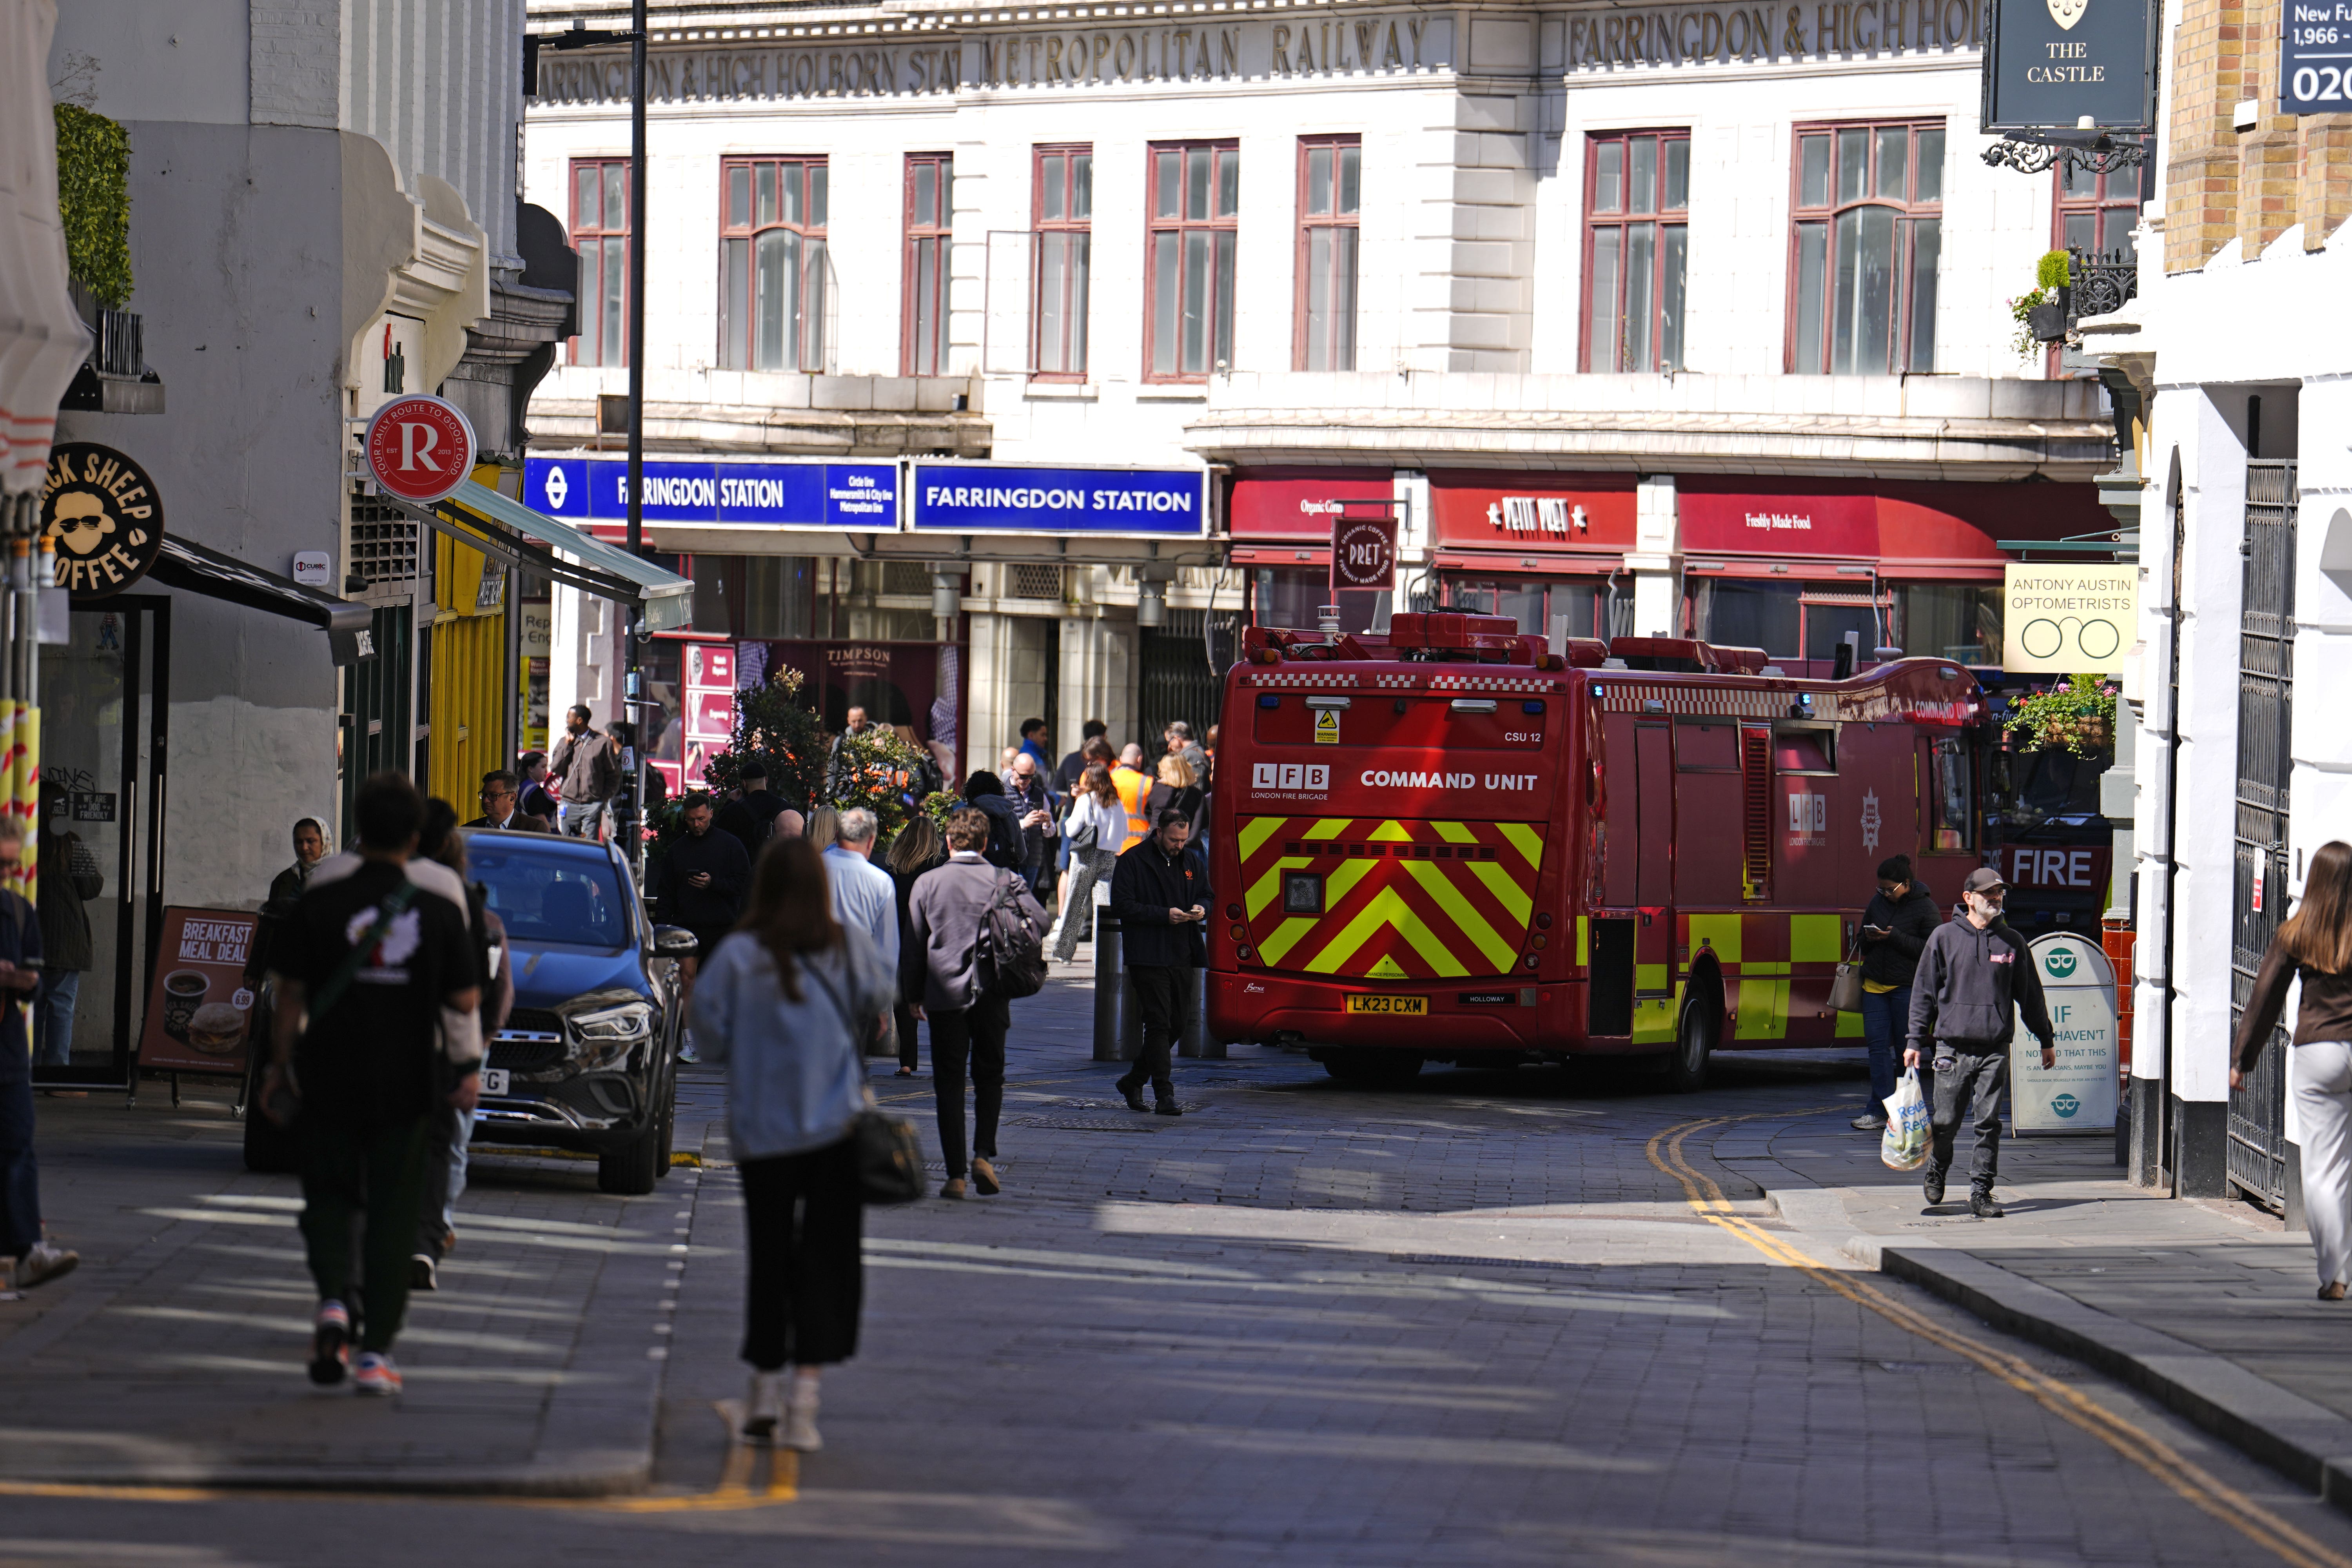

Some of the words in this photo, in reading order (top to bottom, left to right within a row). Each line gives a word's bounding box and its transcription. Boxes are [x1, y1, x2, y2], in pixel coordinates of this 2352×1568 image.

[2294, 4, 2331, 22] New
[1570, 9, 1773, 65] FARRINGDON
[1783, 5, 1806, 56] &
[1816, 0, 1906, 53] HIGH
[2293, 27, 2338, 47] 1,966
[980, 27, 1240, 87] METROPOLITAN
[1270, 18, 1430, 73] RAILWAY
[2046, 43, 2087, 58] THE
[682, 60, 699, 102] &
[706, 55, 767, 101] HIGH
[776, 49, 898, 99] HOLBORN
[2027, 66, 2104, 83] CASTLE
[390, 404, 425, 419] ROUTE
[429, 406, 442, 417] TO
[374, 418, 390, 446] DAILY
[443, 416, 463, 444] GOOD
[396, 423, 445, 472] R
[374, 449, 388, 477] YOUR
[84, 453, 152, 519] SHEEP
[849, 475, 864, 487] Circle
[864, 476, 875, 487] line
[618, 476, 716, 506] FRINGDON
[720, 478, 783, 508] STATION
[830, 488, 865, 499] Hammersmith
[866, 489, 871, 500] &
[871, 489, 882, 503] City
[882, 489, 893, 501] line
[926, 486, 1085, 510] FARRINGDON
[1093, 489, 1191, 512] STATION
[840, 501, 873, 514] Metropolitan
[873, 502, 883, 513] line
[1300, 499, 1324, 516] Organic
[1502, 496, 1537, 530] PETIT
[1537, 498, 1570, 532] PRET
[1746, 512, 1771, 531] Freshly
[1771, 512, 1792, 529] Made
[1793, 514, 1811, 530] Food
[1341, 524, 1367, 545] ORGANIC
[1368, 524, 1389, 545] COFFEE
[1349, 543, 1380, 566] PRET
[54, 543, 141, 590] OFFEE
[1338, 559, 1359, 583] FRESHLY
[1359, 573, 1377, 584] MADE
[1377, 559, 1390, 577] FOOD
[2013, 579, 2075, 591] ANTONY
[2078, 579, 2131, 591] AUSTIN
[2012, 597, 2131, 610] OPTOMETRISTS
[827, 647, 891, 662] TIMPSON
[1915, 700, 1954, 719] COMMAND
[1504, 732, 1527, 742] CSU
[1530, 733, 1541, 742] 12
[1259, 768, 1323, 785] LFB
[1361, 770, 1475, 789] COMMAND
[1485, 774, 1538, 791] UNIT
[83, 794, 93, 803] WE
[95, 795, 107, 803] ARE
[1789, 837, 1804, 846] LONDON
[2012, 849, 2092, 886] FIRE
[182, 922, 253, 944] BREAKFAST
[179, 940, 212, 960] MEAL
[216, 943, 246, 962] DEAL
[235, 995, 250, 1005] 6.99
[1354, 997, 1390, 1012] LK23
[1394, 998, 1422, 1013] CXM
[2054, 1005, 2072, 1023] IF
[2054, 1029, 2105, 1041] HAVEN'T
[2064, 1049, 2085, 1057] THAT
